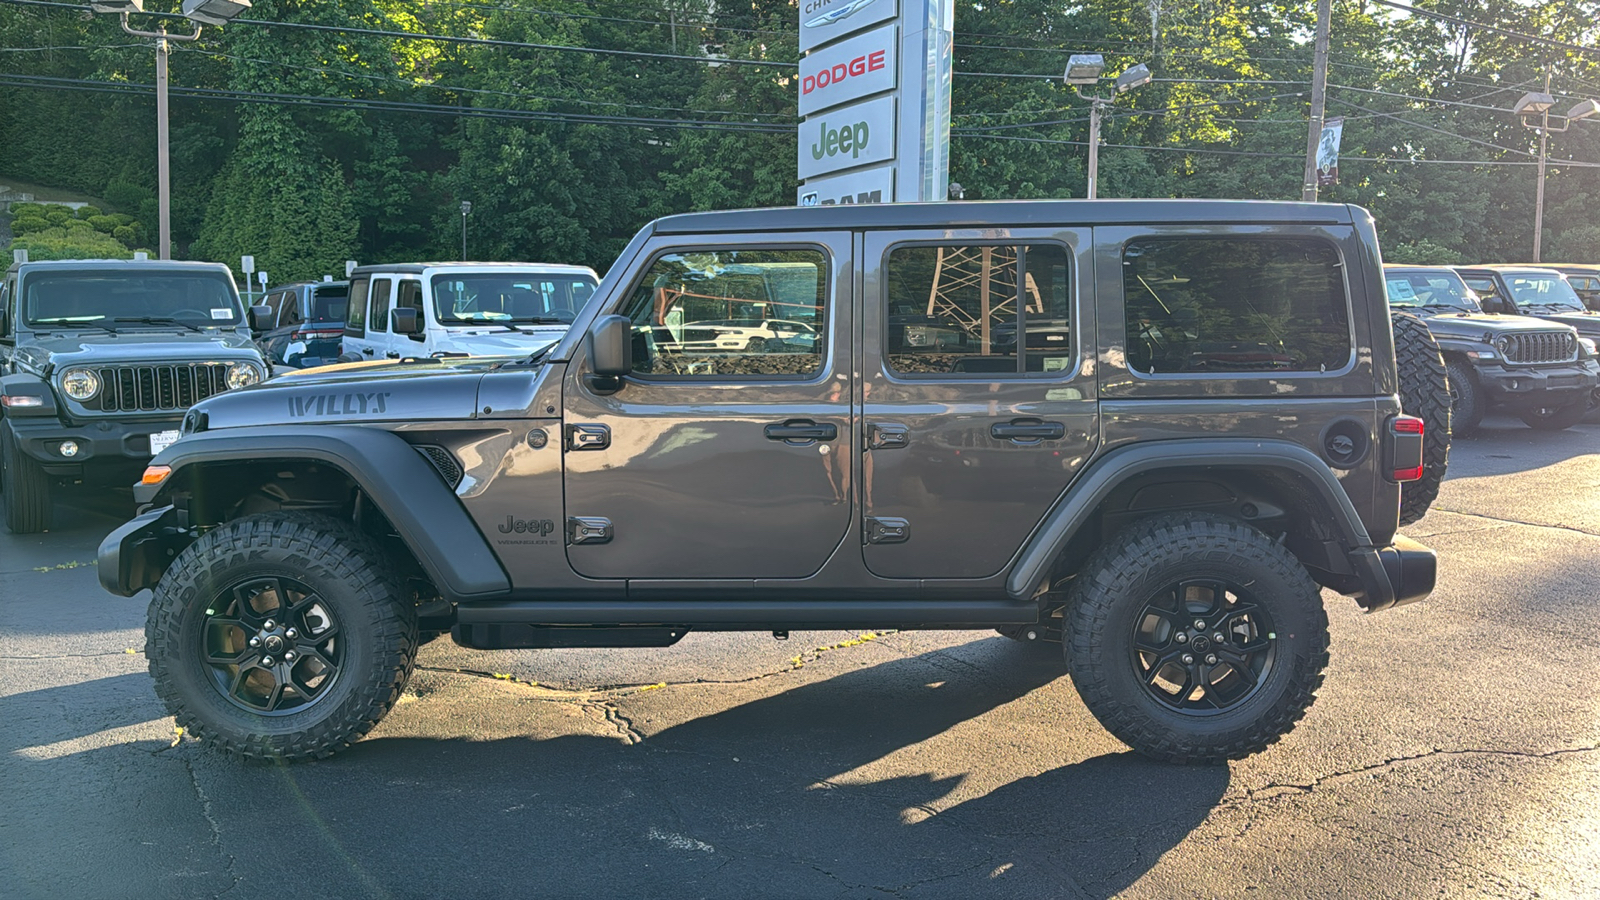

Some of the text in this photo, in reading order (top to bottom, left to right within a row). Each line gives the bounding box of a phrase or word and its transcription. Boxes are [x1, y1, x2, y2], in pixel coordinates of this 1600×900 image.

[802, 49, 885, 95] DODGE
[811, 120, 869, 161] Jeep
[287, 392, 391, 417] WILLYS
[498, 515, 554, 537] Jeep
[167, 549, 269, 660] WILDPEAK
